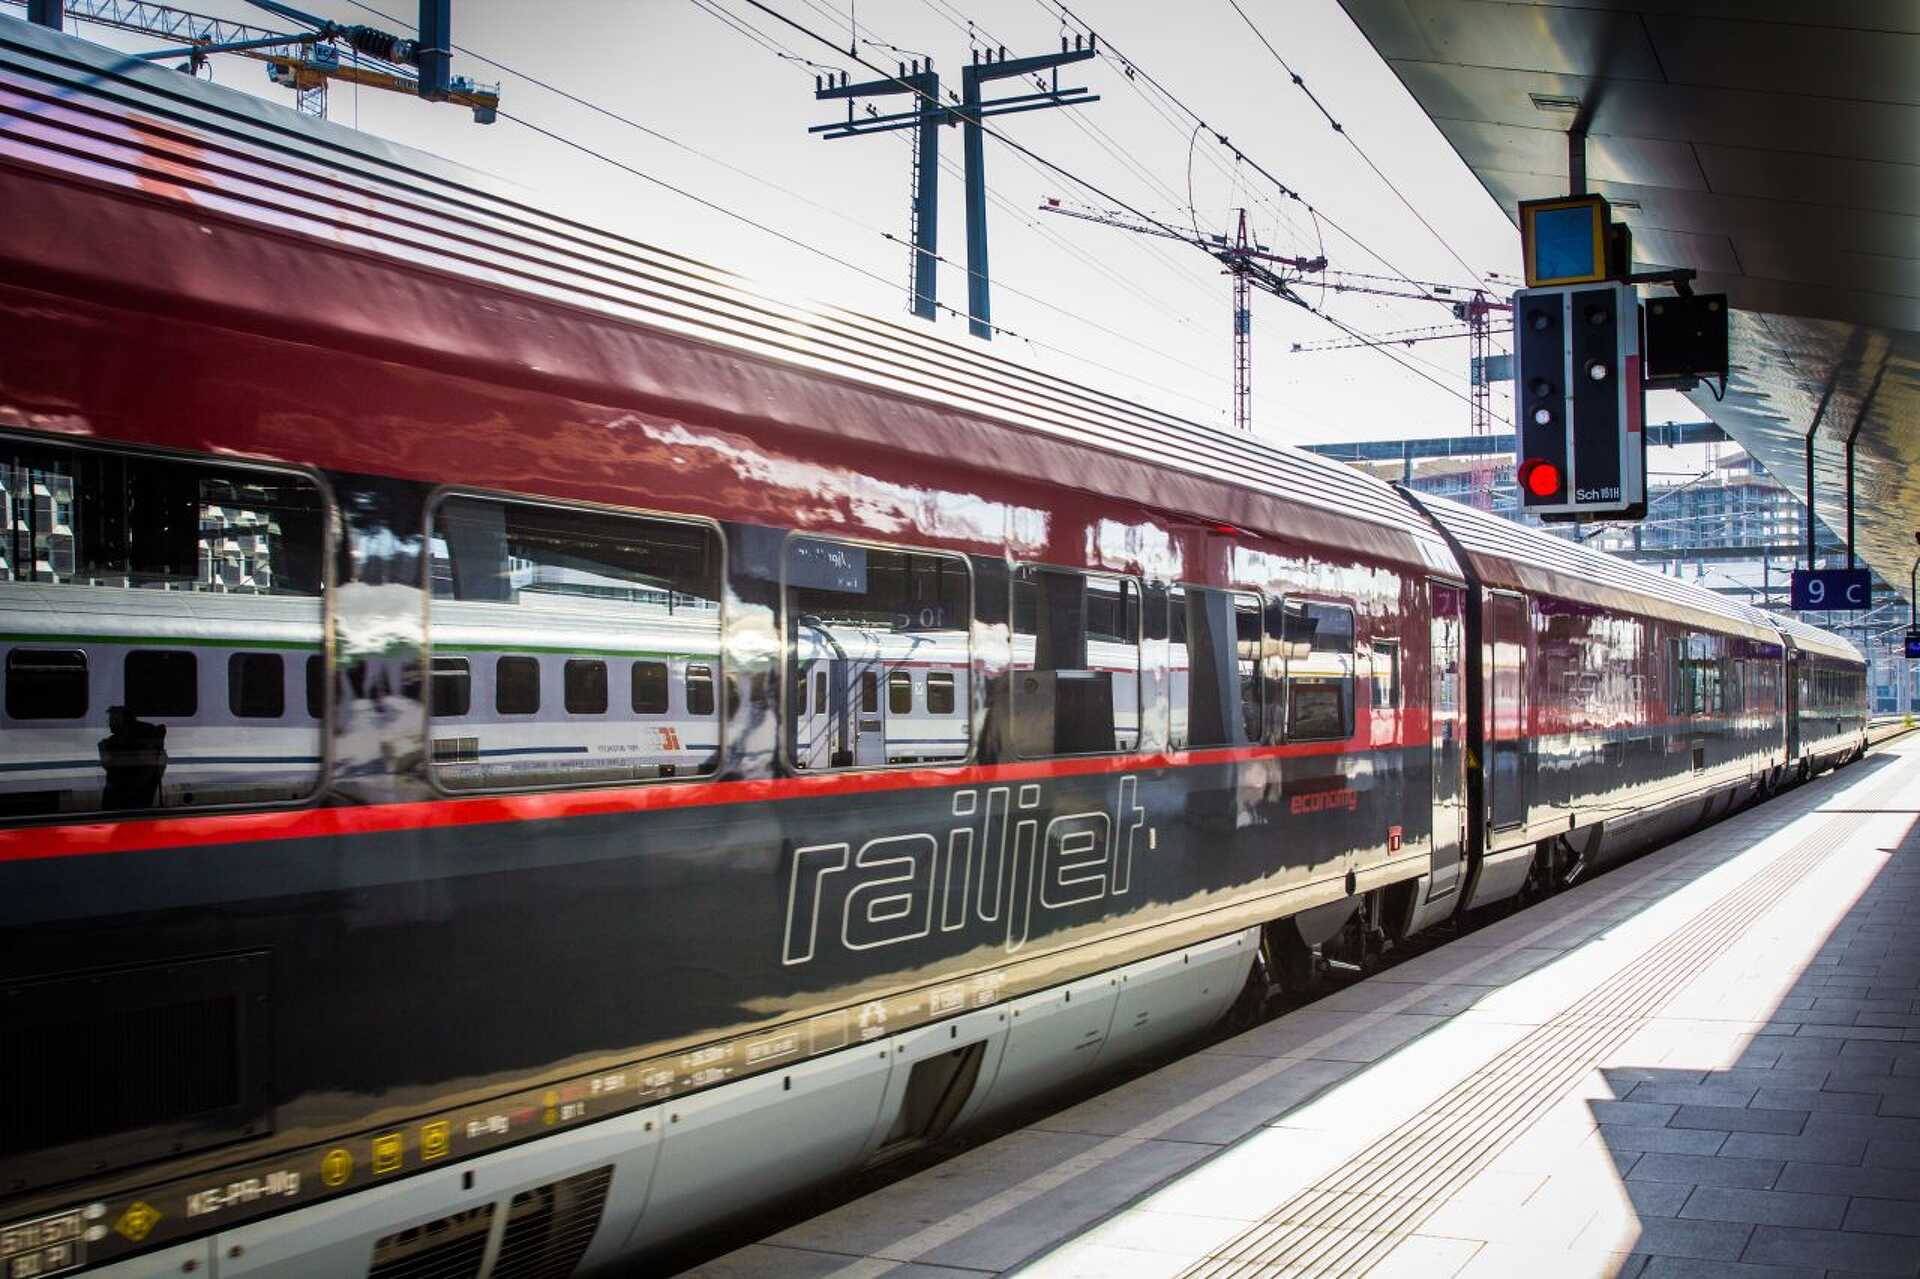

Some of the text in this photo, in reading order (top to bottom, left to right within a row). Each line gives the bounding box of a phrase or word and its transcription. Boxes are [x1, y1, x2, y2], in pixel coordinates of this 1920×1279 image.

[1808, 579, 1825, 604] 9
[1290, 786, 1358, 815] economy
[782, 775, 1144, 967] railjet
